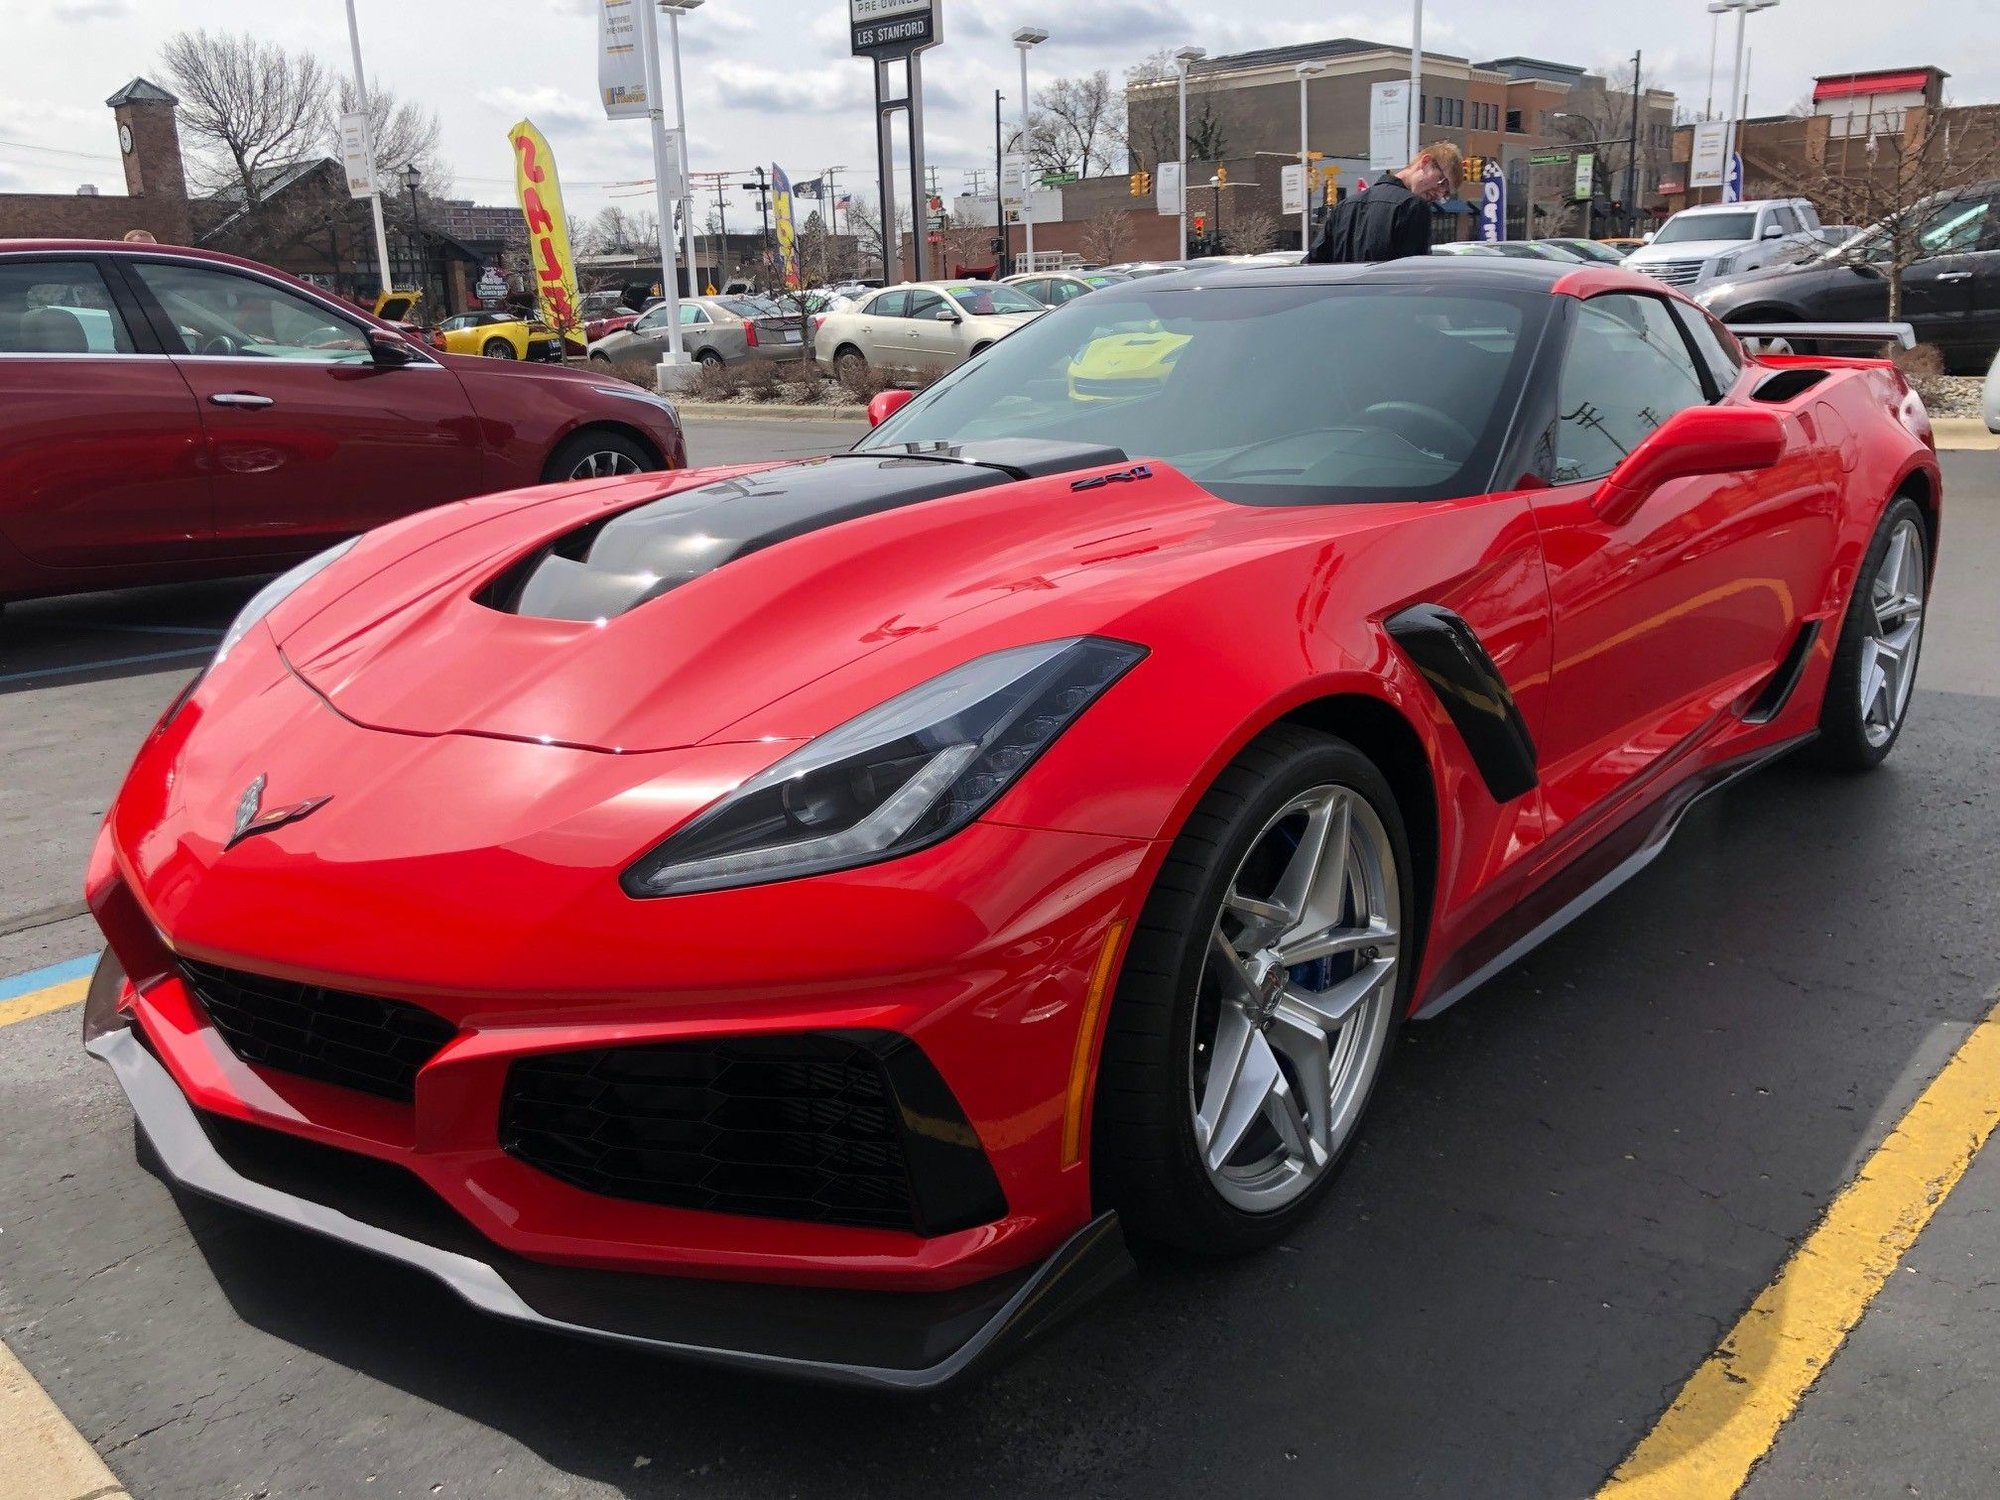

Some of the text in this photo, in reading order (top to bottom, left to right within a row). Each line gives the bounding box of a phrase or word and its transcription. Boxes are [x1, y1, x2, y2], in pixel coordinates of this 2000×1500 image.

[857, 0, 920, 13] PRE-OWN
[857, 20, 925, 46] LES STANFORD
[1071, 464, 1153, 492] ZR1
